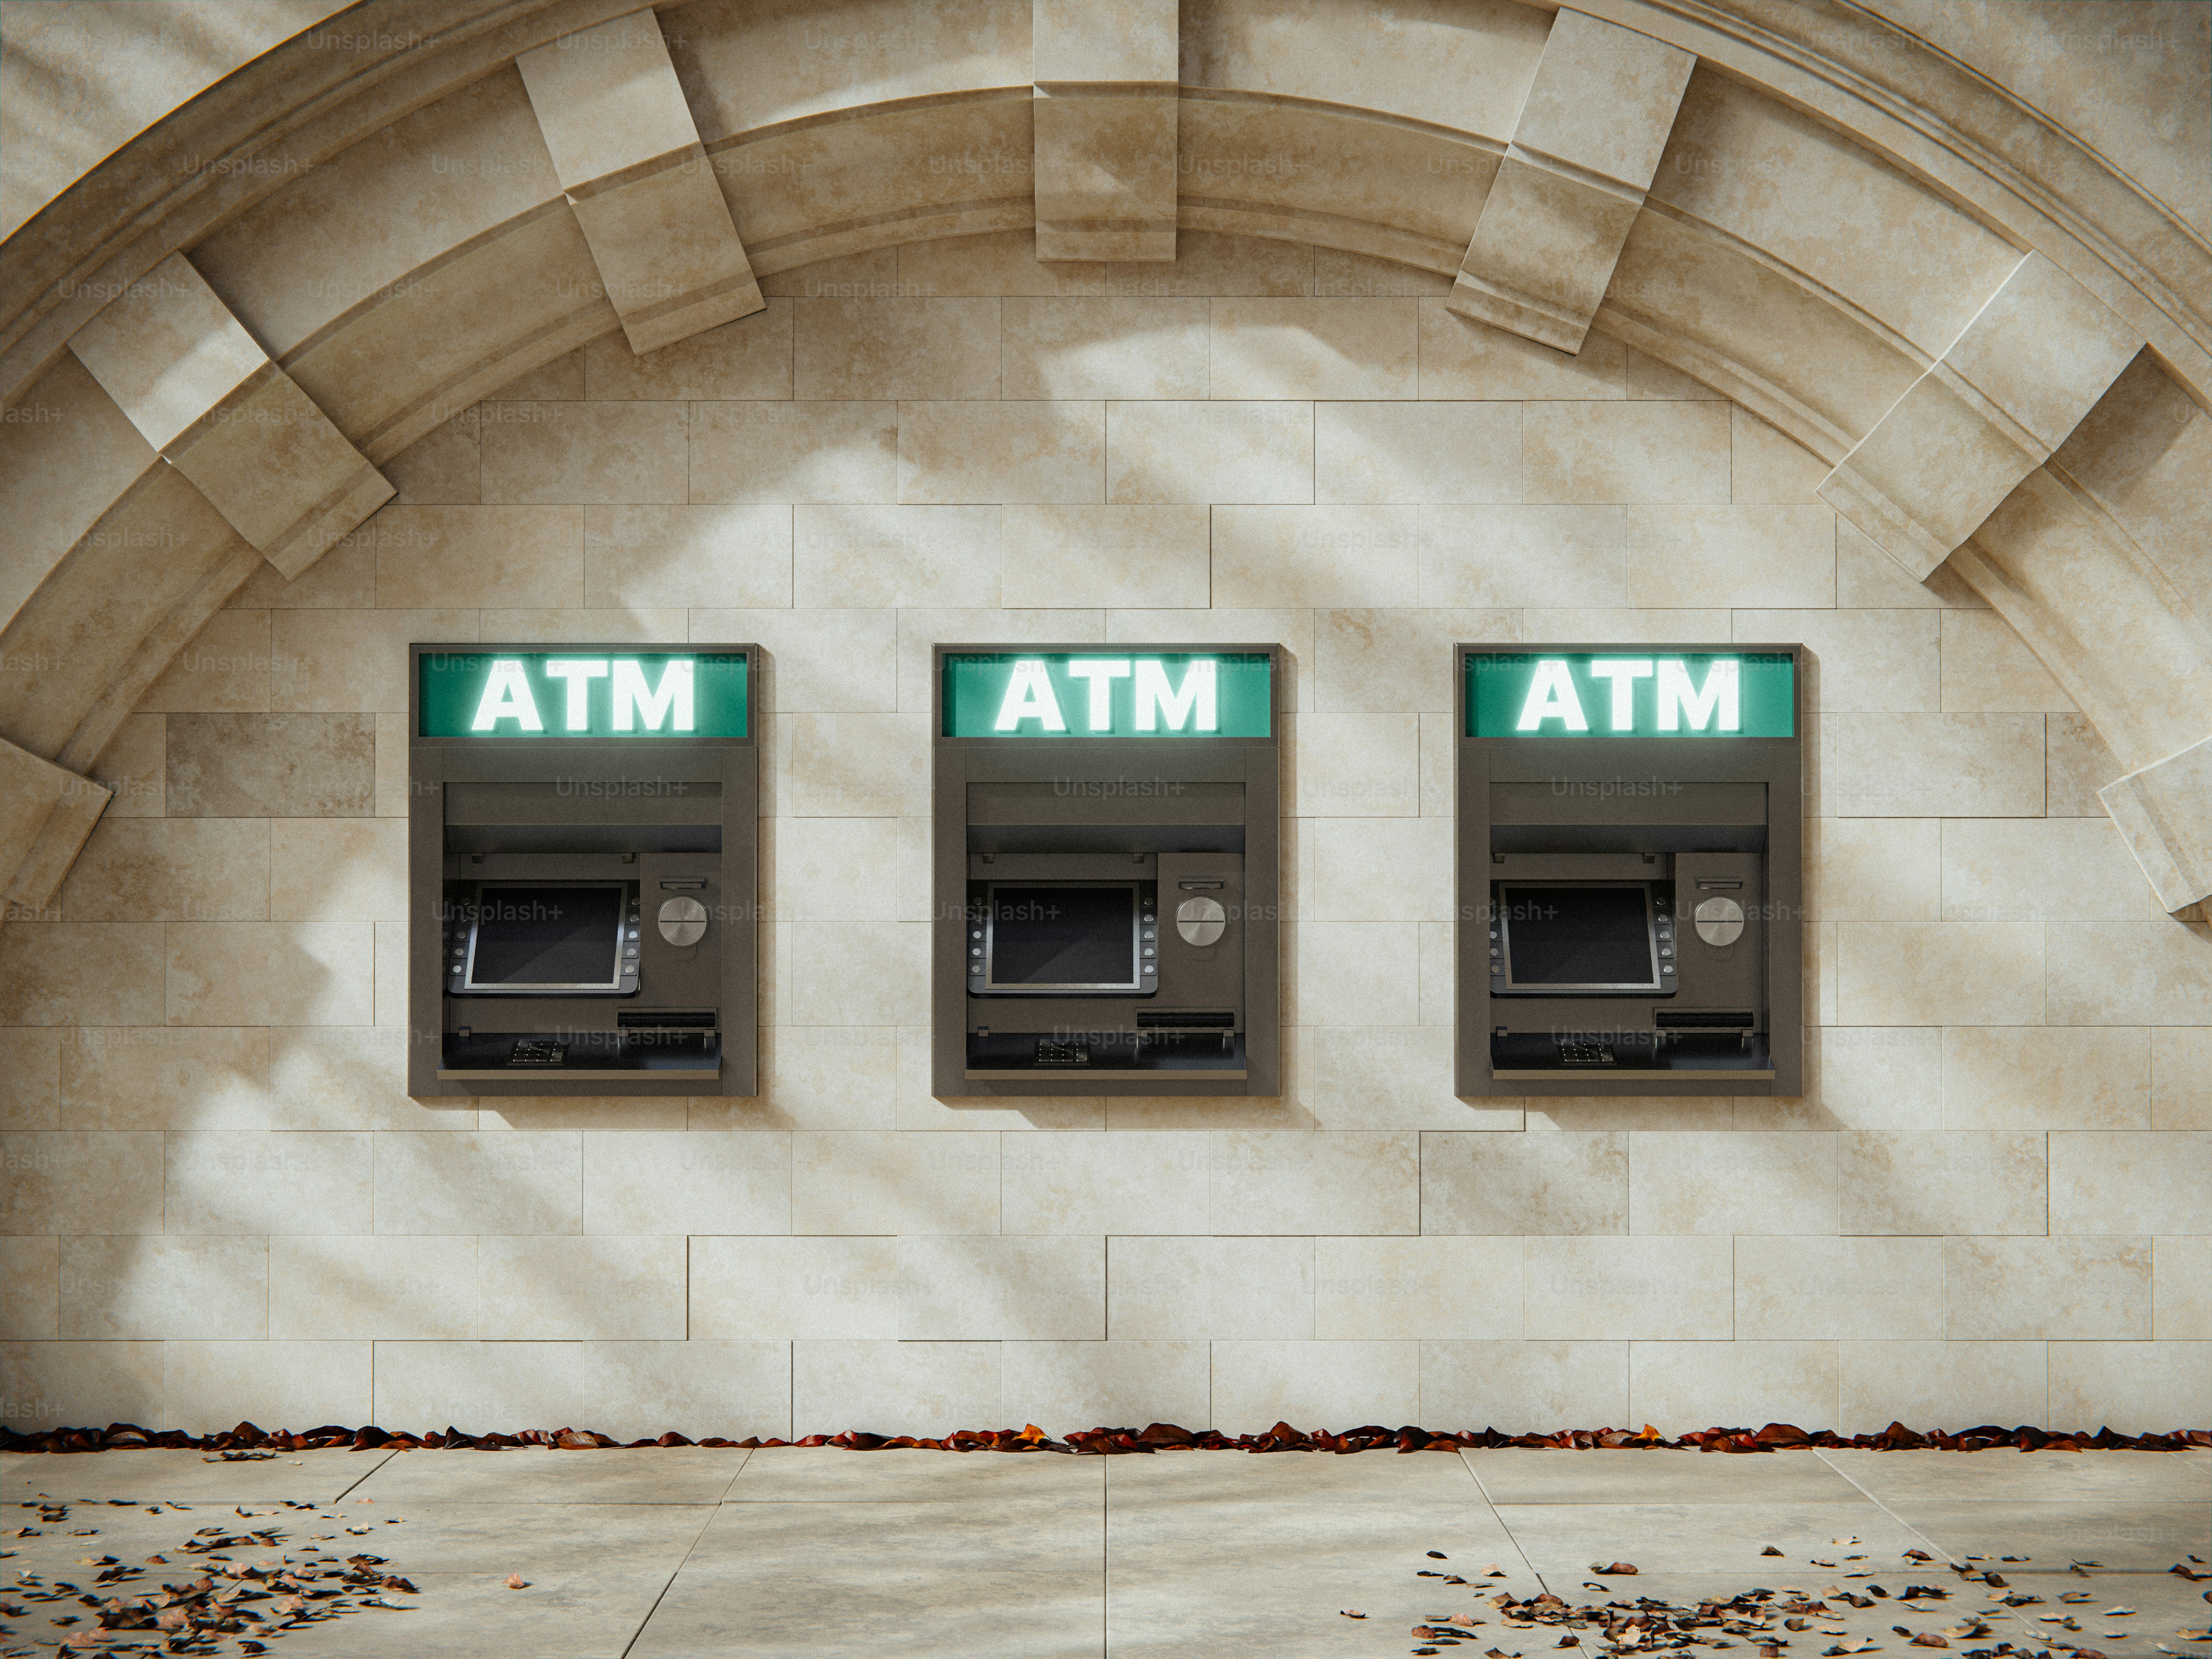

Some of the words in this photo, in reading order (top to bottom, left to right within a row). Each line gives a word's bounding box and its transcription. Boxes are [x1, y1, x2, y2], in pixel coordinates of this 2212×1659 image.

[471, 660, 693, 730] ATM
[994, 660, 1216, 730] ATM
[1517, 660, 1739, 730] ATM
